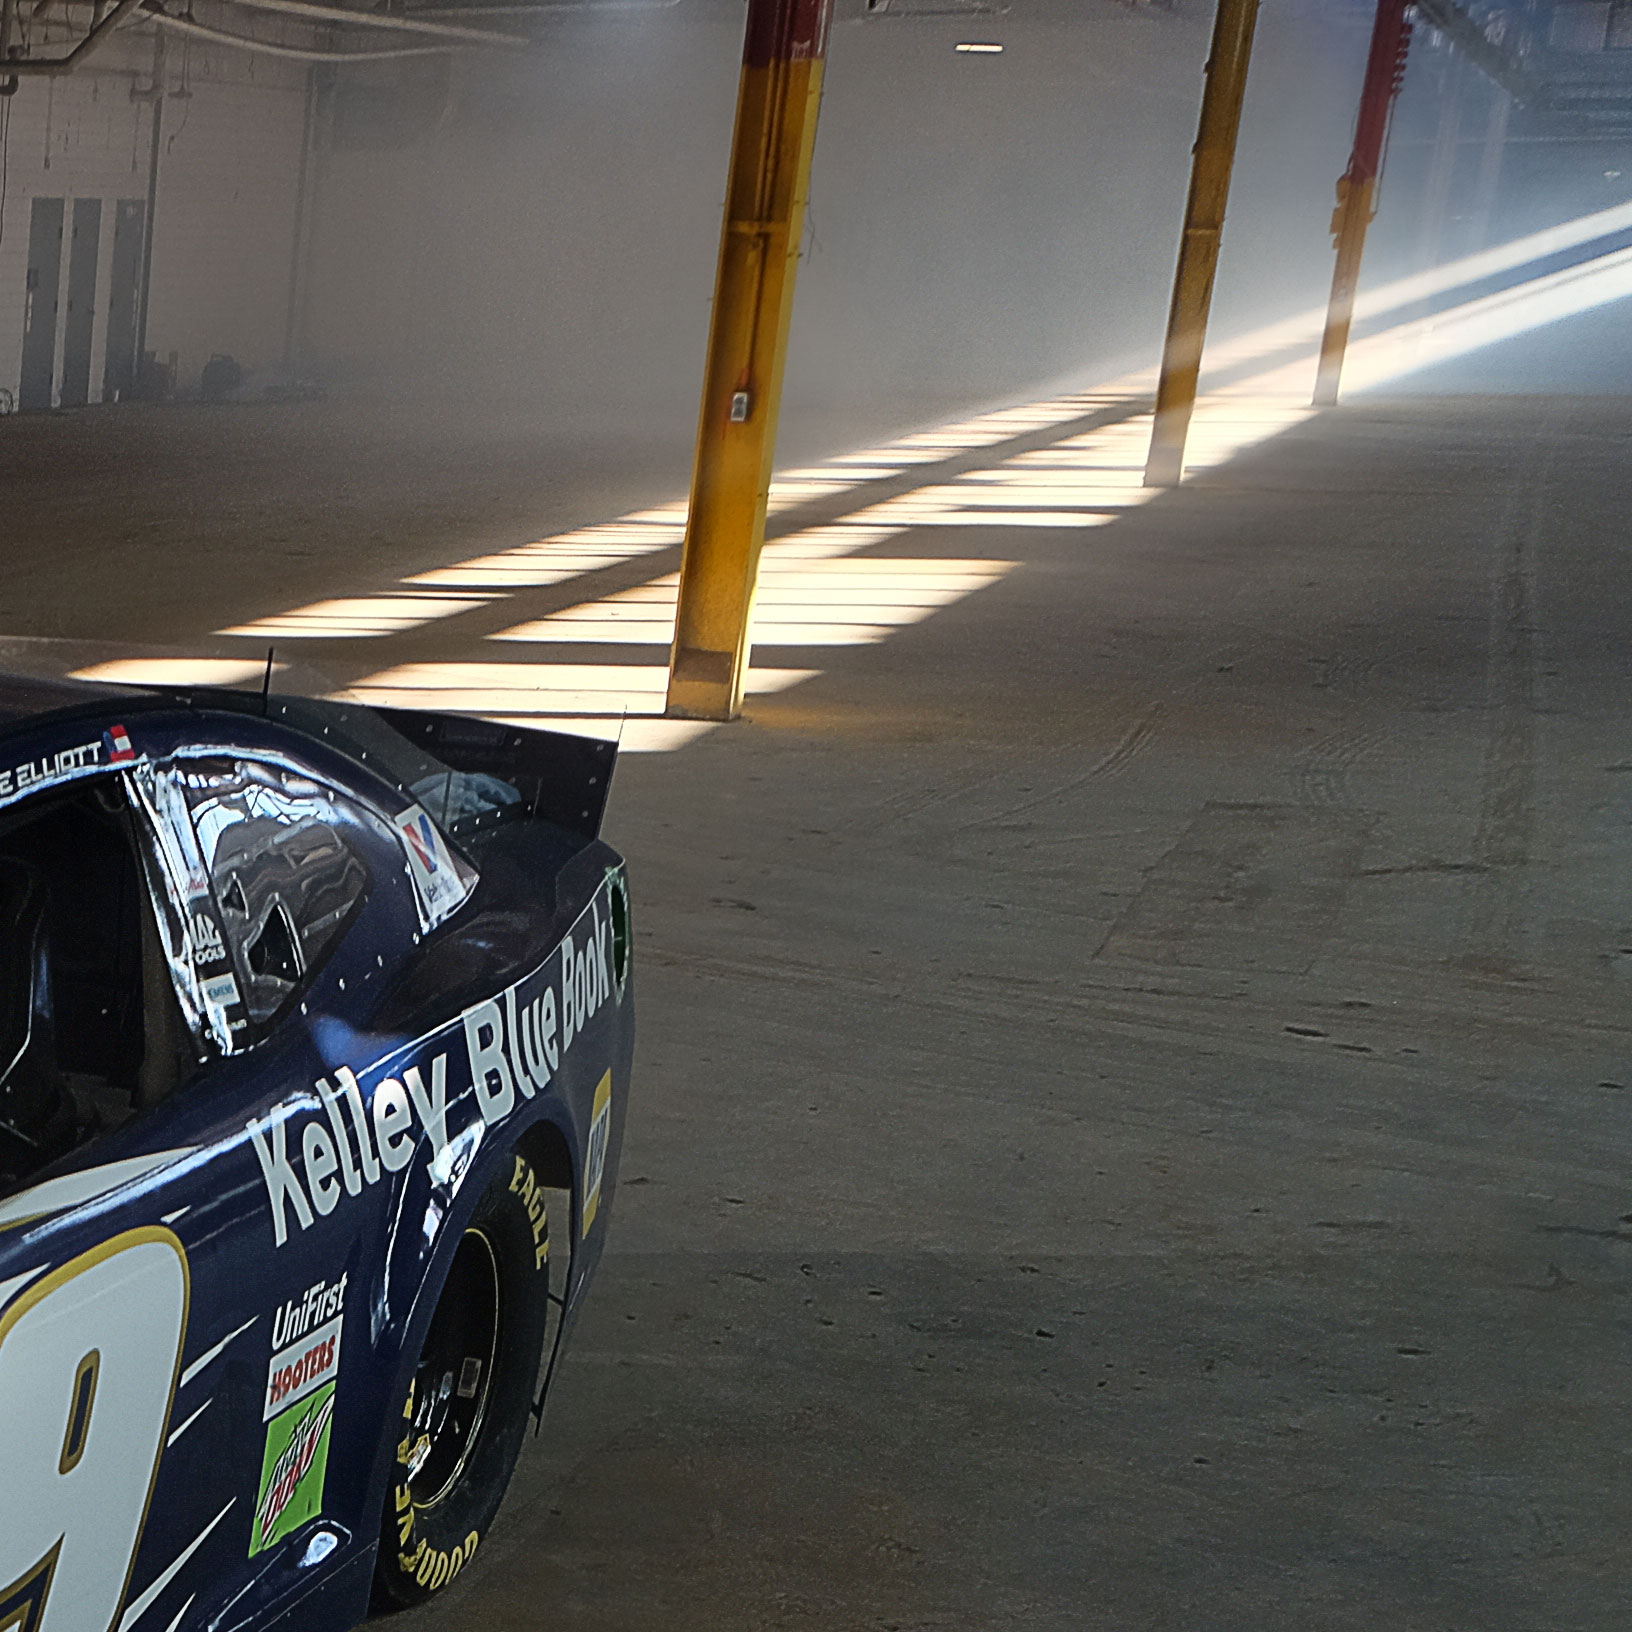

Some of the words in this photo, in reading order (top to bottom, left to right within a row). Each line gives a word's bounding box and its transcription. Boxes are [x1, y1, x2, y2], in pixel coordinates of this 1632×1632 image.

[15, 740, 102, 787] ELLIOTT
[244, 1052, 450, 1248] Kelley
[461, 984, 559, 1128] Blue
[560, 900, 610, 1053] Book
[509, 1154, 550, 1271] EAGLE
[271, 1271, 348, 1351] UniFirst
[268, 1334, 337, 1406] HOOTERS
